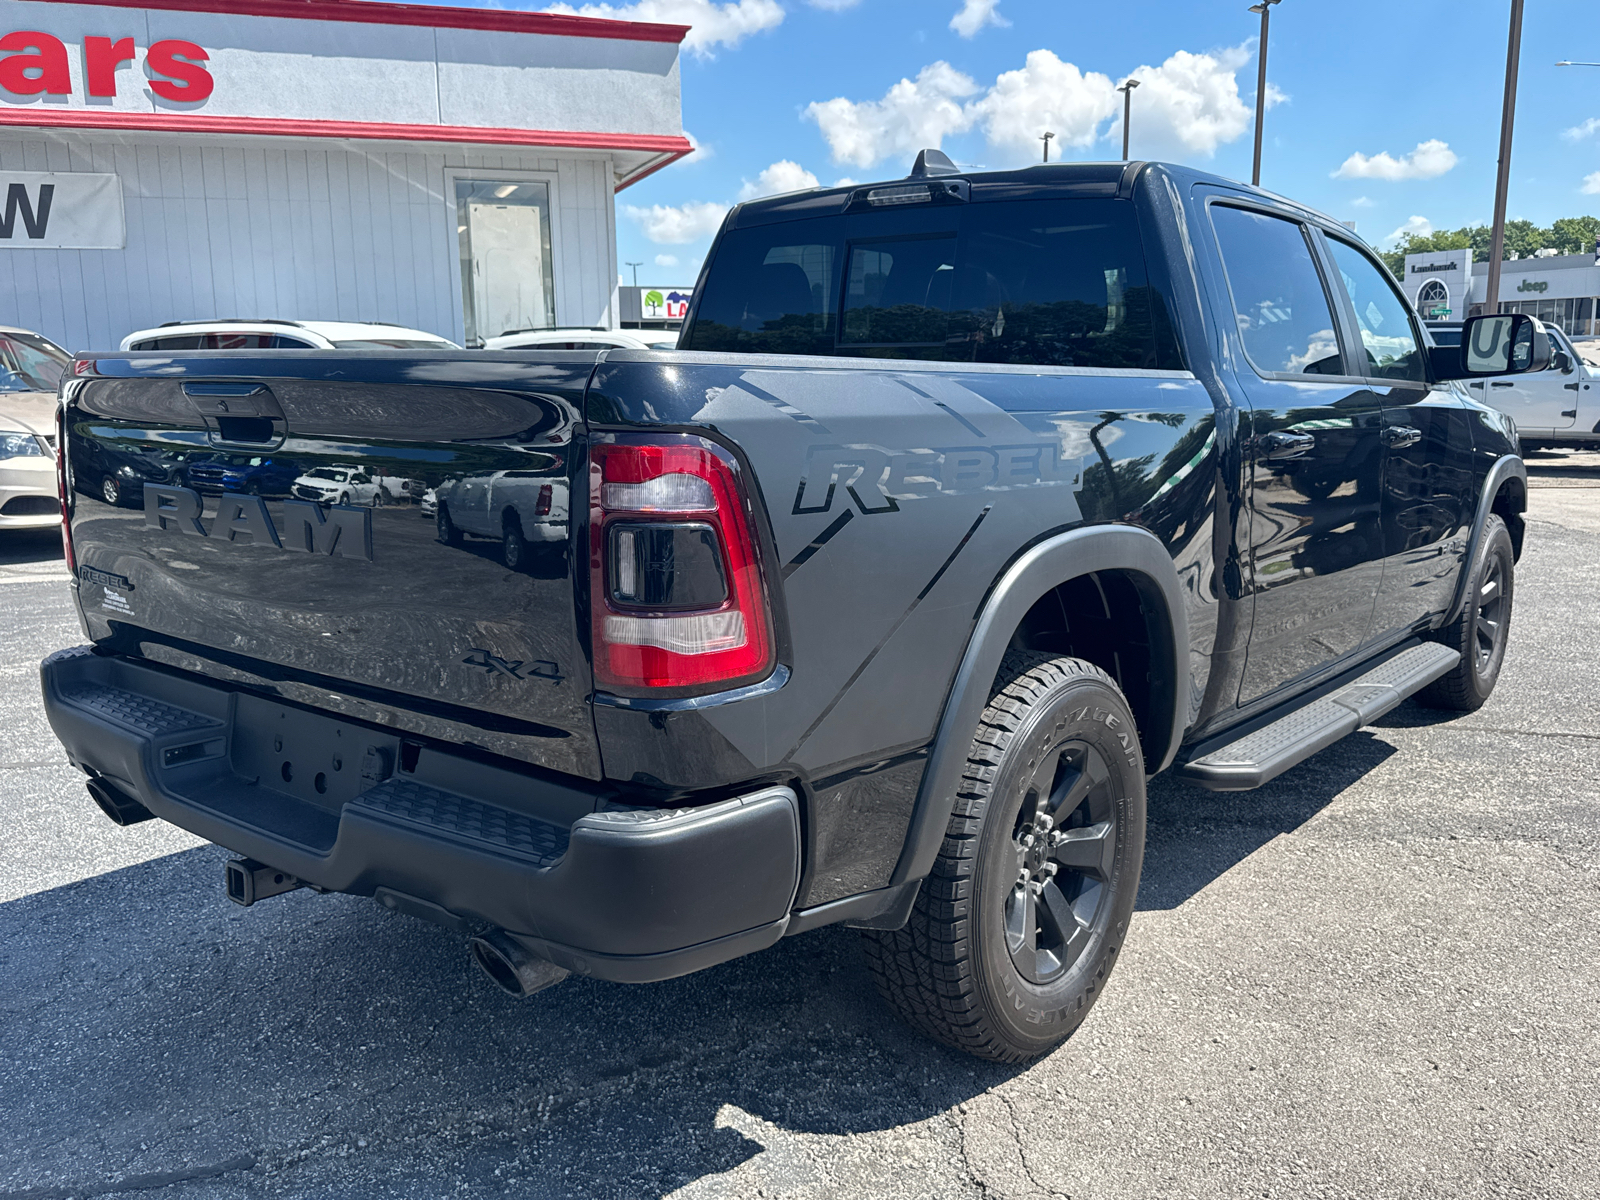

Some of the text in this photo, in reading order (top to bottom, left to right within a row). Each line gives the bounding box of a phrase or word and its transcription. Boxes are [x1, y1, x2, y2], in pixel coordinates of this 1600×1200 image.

[0, 30, 214, 102] ars
[1411, 261, 1457, 273] Landmark
[1516, 279, 1549, 293] Jeep
[791, 443, 1084, 515] REBEL
[143, 482, 373, 562] RAM
[79, 565, 132, 590] REBEL
